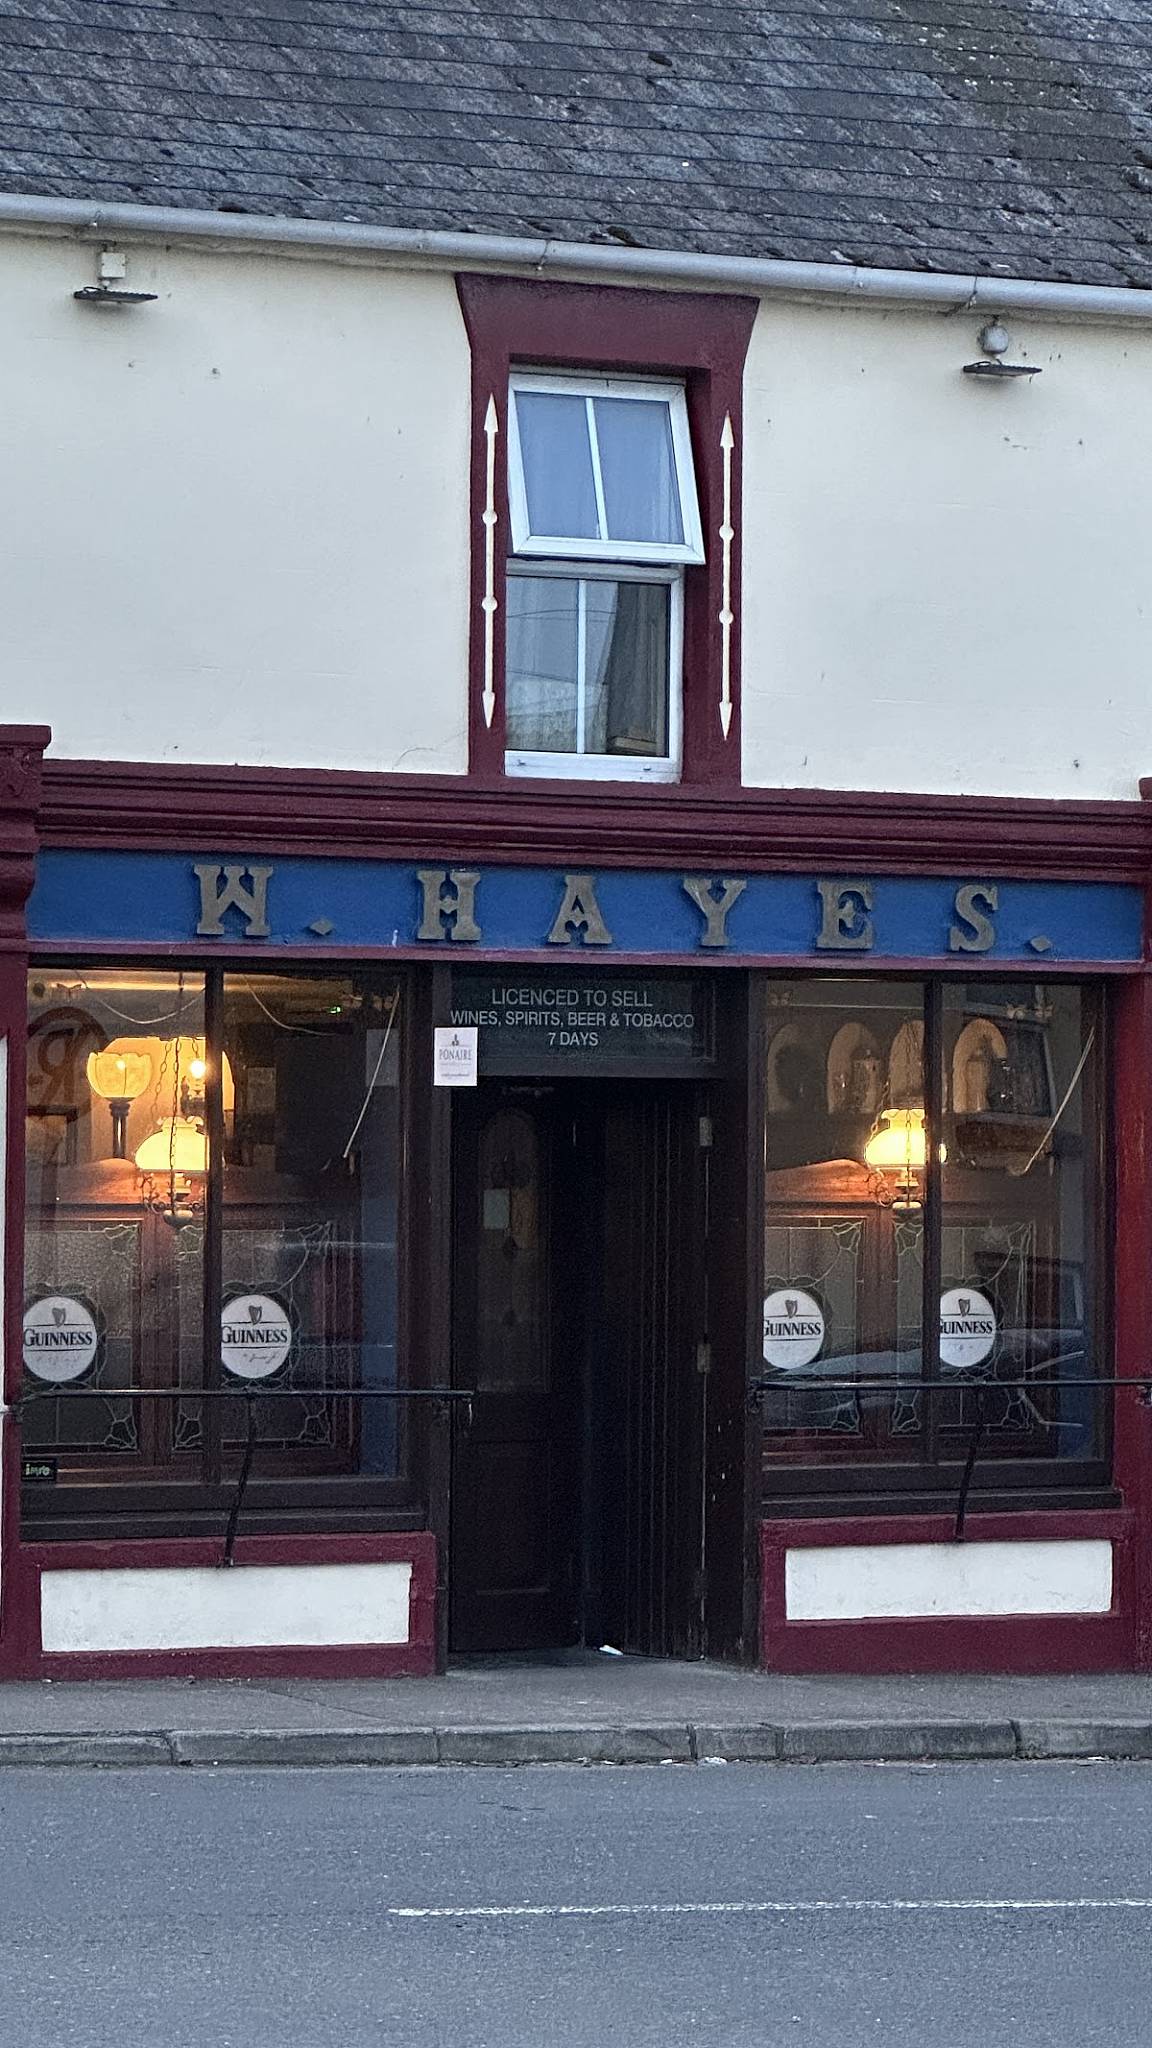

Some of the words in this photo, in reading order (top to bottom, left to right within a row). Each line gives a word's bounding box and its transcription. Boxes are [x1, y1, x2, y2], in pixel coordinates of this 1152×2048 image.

[491, 989, 579, 1006] LICENCED
[583, 989, 607, 1007] TO
[612, 990, 653, 1007] SELL
[450, 1010, 501, 1026] WINES,
[505, 1011, 563, 1028] SPIRITS,
[568, 1012, 605, 1026] BEER
[609, 1012, 620, 1026] &
[625, 1013, 695, 1028] TOBACCO
[549, 1032, 556, 1046] 7
[560, 1032, 599, 1046] DAYS
[221, 1325, 288, 1344] GUINNESS
[940, 1318, 993, 1334] UINNESS
[23, 1328, 93, 1347] GUINNESS
